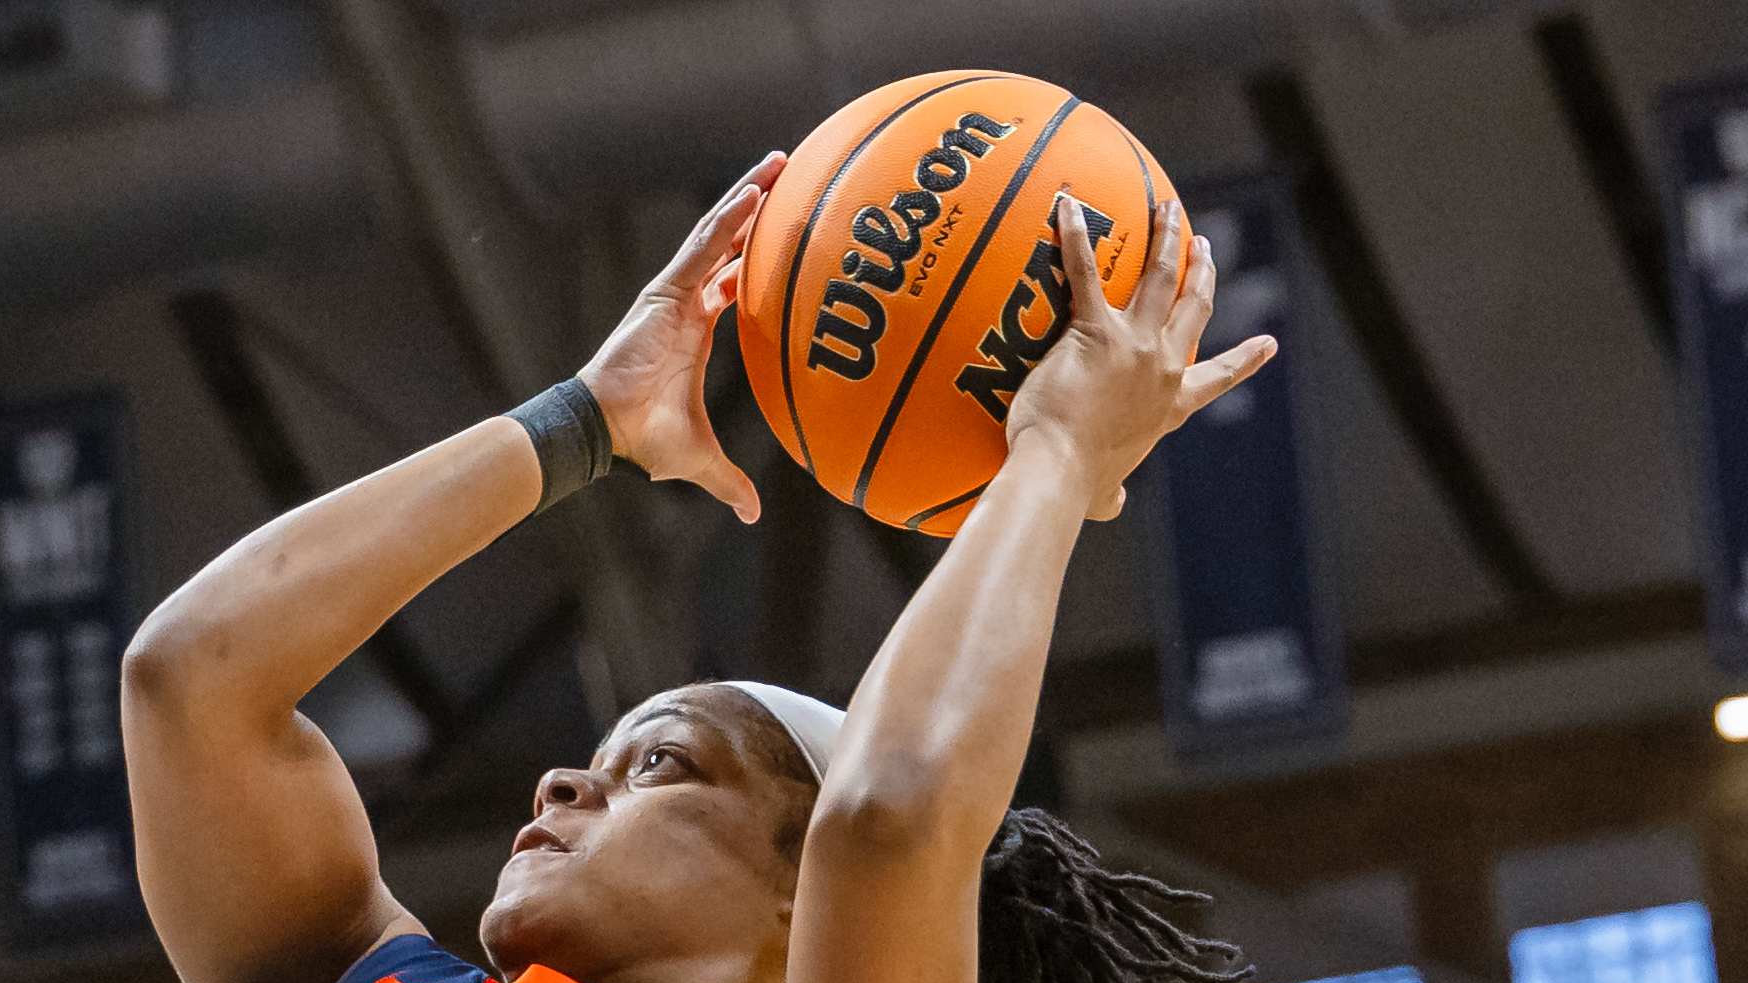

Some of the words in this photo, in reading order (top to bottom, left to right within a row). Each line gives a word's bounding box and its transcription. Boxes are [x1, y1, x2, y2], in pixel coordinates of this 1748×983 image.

[806, 112, 1017, 382] Wilson
[908, 251, 938, 298] EVO
[932, 202, 964, 247] NXT
[1100, 231, 1130, 283] BALL
